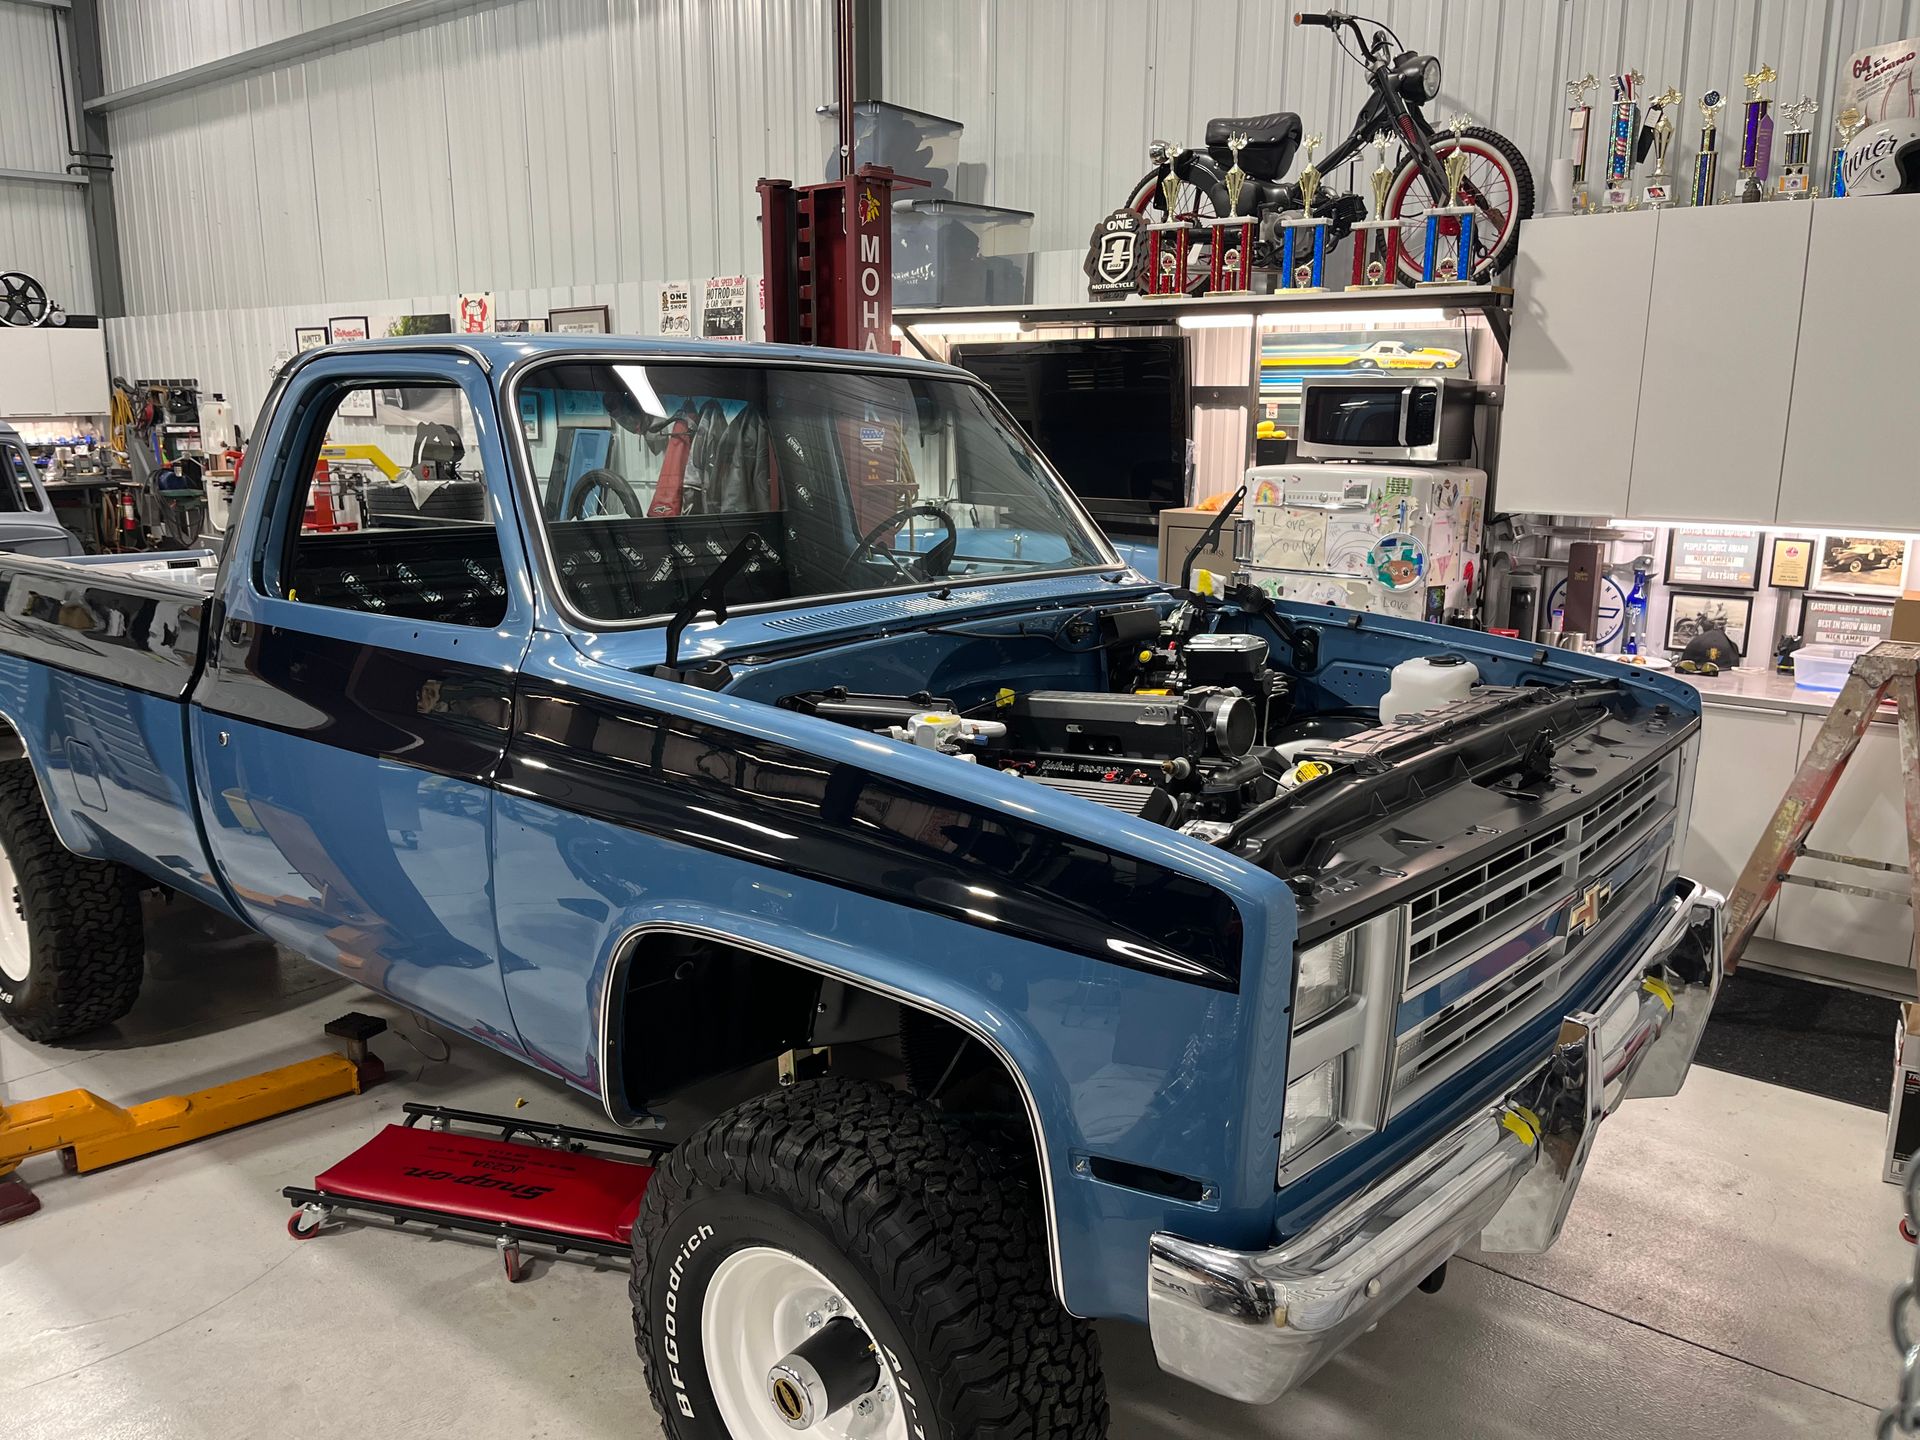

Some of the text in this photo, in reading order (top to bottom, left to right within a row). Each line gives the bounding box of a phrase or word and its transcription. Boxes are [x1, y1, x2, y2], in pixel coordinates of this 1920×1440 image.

[1853, 55, 1871, 79] 64
[1864, 51, 1916, 82] CAMINO
[1106, 218, 1134, 231] ONE
[1091, 281, 1135, 290] MOTORCYCLE
[669, 292, 688, 301] ONE
[706, 286, 730, 301] HOTROD
[710, 300, 719, 308] CAR
[720, 299, 732, 307] SHOW
[301, 334, 322, 343] HUNTER
[1706, 571, 1739, 581] EASTSIDE
[1811, 602, 1837, 613] EASTSIDE
[1817, 619, 1832, 629] BEST
[1832, 620, 1841, 629] IN
[1840, 621, 1860, 631] SHOW
[1858, 623, 1882, 633] AWARD
[1825, 632, 1870, 643] NICK LAMPERT
[403, 1167, 555, 1200] Snap-on
[664, 1223, 715, 1419] BFGoodrich
